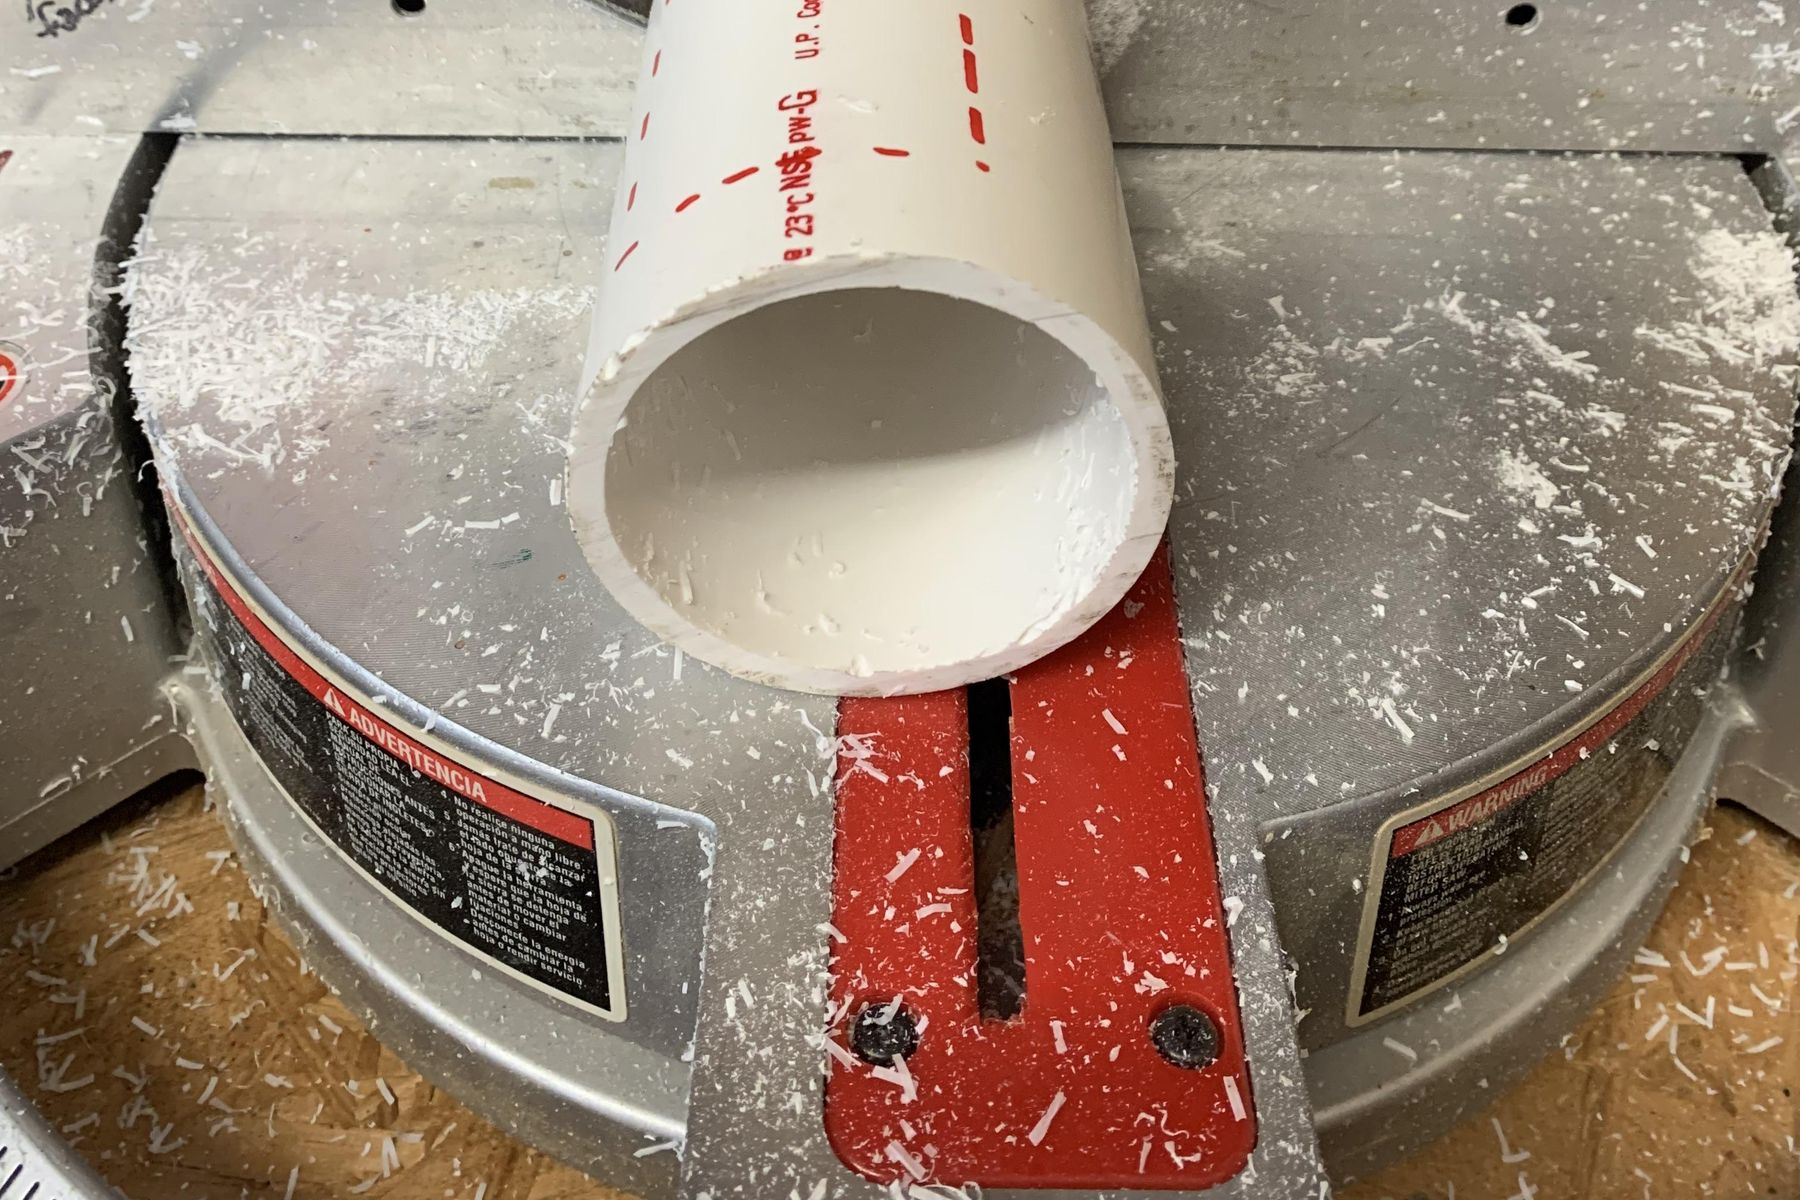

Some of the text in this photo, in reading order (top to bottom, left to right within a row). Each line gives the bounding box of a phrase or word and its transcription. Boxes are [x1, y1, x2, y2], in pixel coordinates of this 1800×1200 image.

[349, 708, 487, 801] ADVERTENCIA
[1449, 765, 1547, 831] WARNING
[460, 837, 482, 858] hoja
[470, 803, 507, 830] realice
[510, 823, 555, 852] ninguna
[493, 835, 519, 857] trate
[520, 837, 552, 860] mano
[461, 848, 500, 877] Apague
[466, 879, 494, 899] antes
[512, 901, 546, 926] mover
[472, 864, 507, 889] espere
[509, 882, 530, 901] que
[546, 898, 570, 918] hoja
[477, 875, 507, 898] sierra
[525, 896, 569, 928] detenga
[467, 887, 511, 917] material
[522, 913, 567, 945] cambiar
[472, 917, 499, 939] antes
[516, 936, 561, 971] cambiar
[473, 926, 495, 946] hoja
[506, 942, 538, 968] rendir
